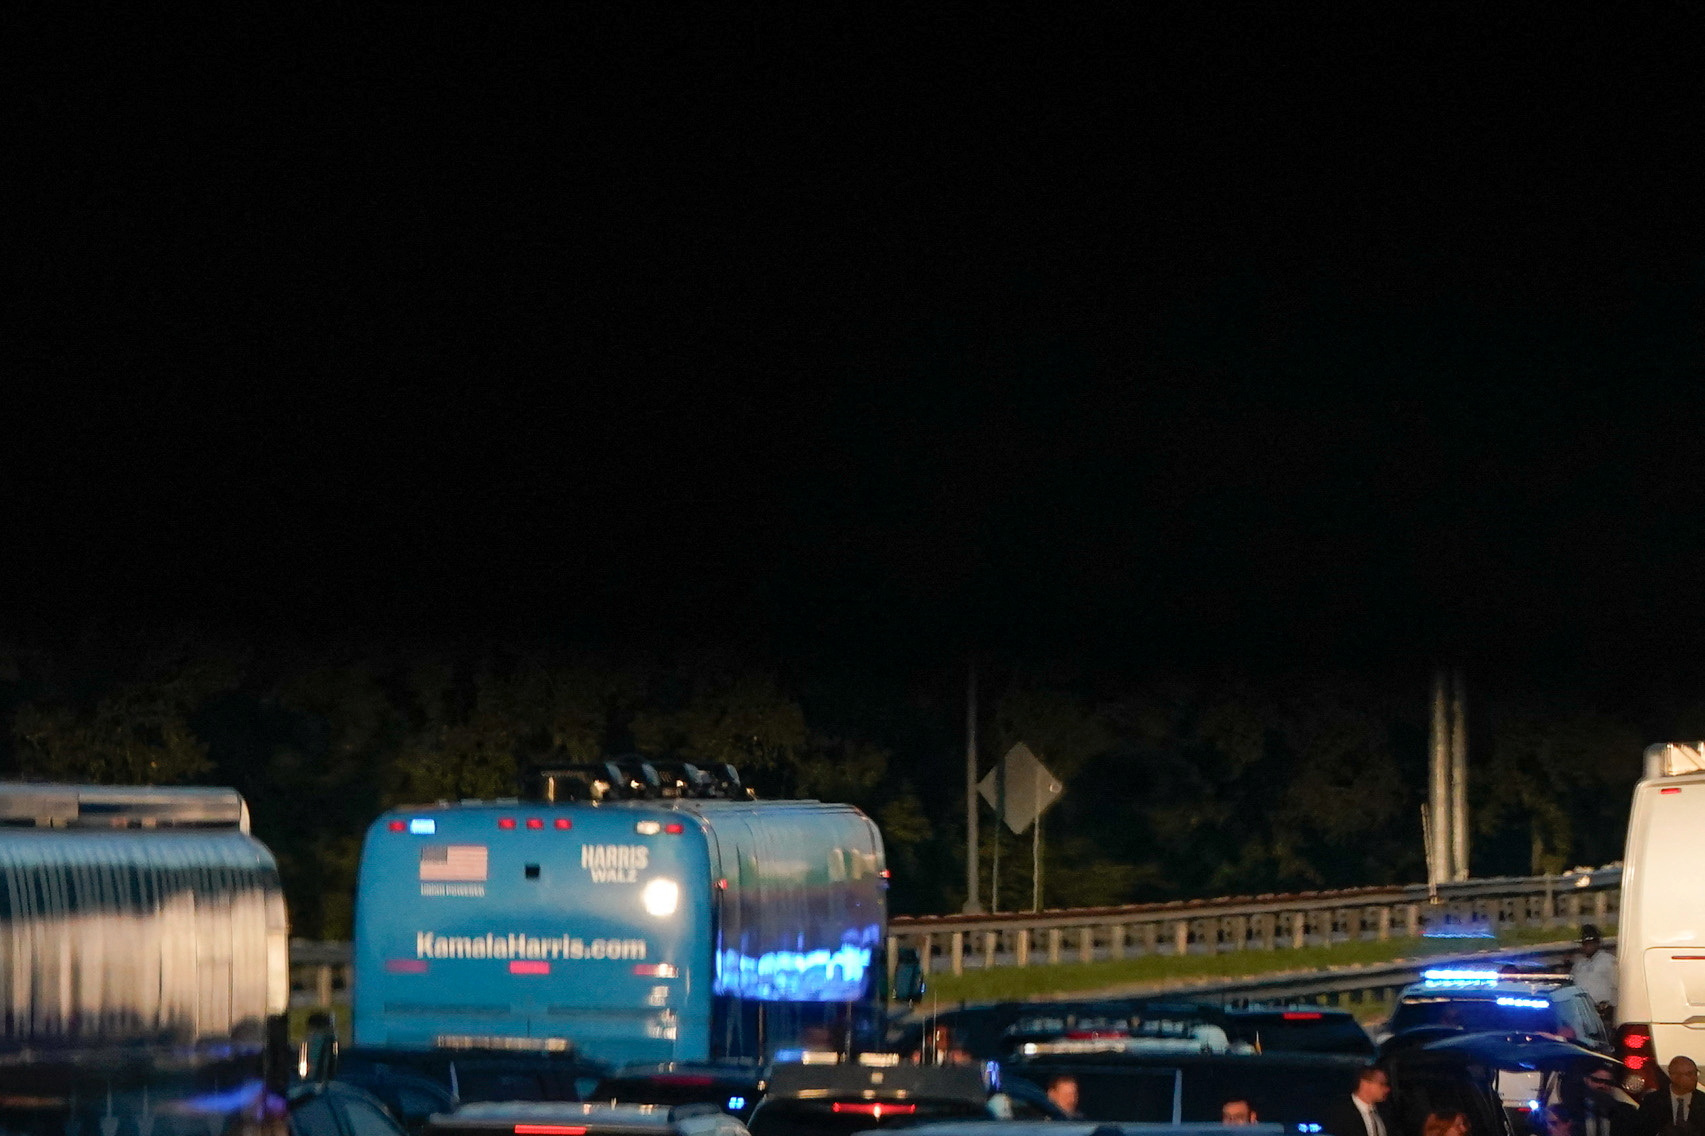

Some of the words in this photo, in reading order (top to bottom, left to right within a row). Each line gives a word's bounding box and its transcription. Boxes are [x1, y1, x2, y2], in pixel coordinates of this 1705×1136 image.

[581, 843, 649, 869] HARRIS
[591, 868, 638, 883] WALZ
[416, 930, 646, 960] KamalaHarris.com
